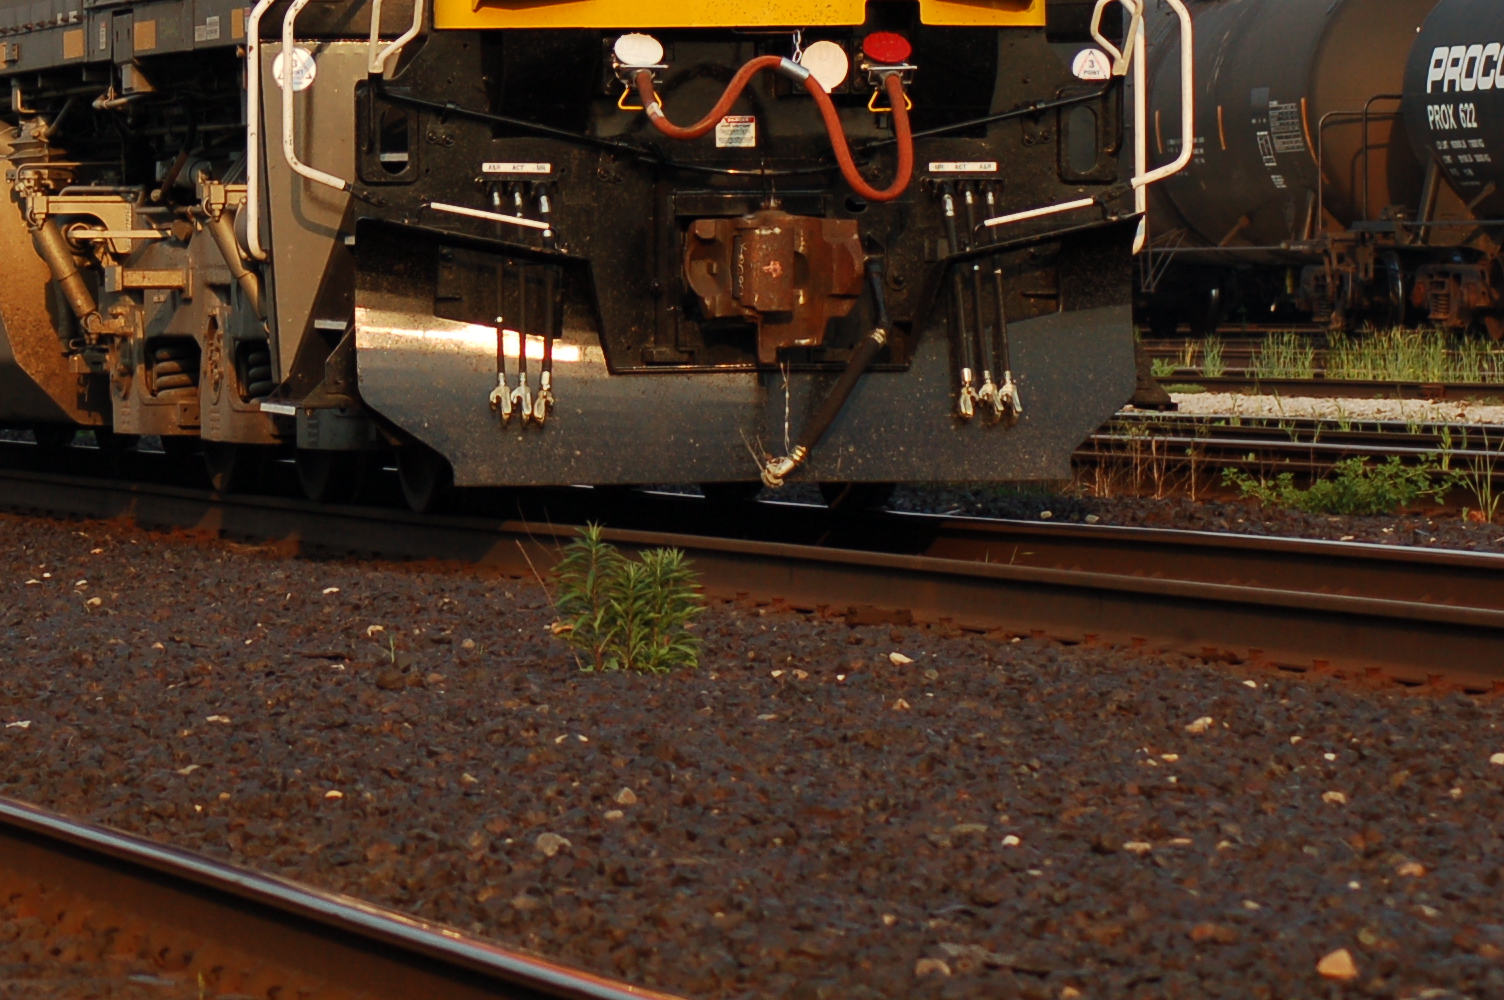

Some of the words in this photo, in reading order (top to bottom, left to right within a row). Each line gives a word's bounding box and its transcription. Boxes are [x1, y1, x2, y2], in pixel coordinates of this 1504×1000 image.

[1088, 59, 1095, 69] 3
[1427, 103, 1457, 130] PROX
[1459, 102, 1478, 129] 622
